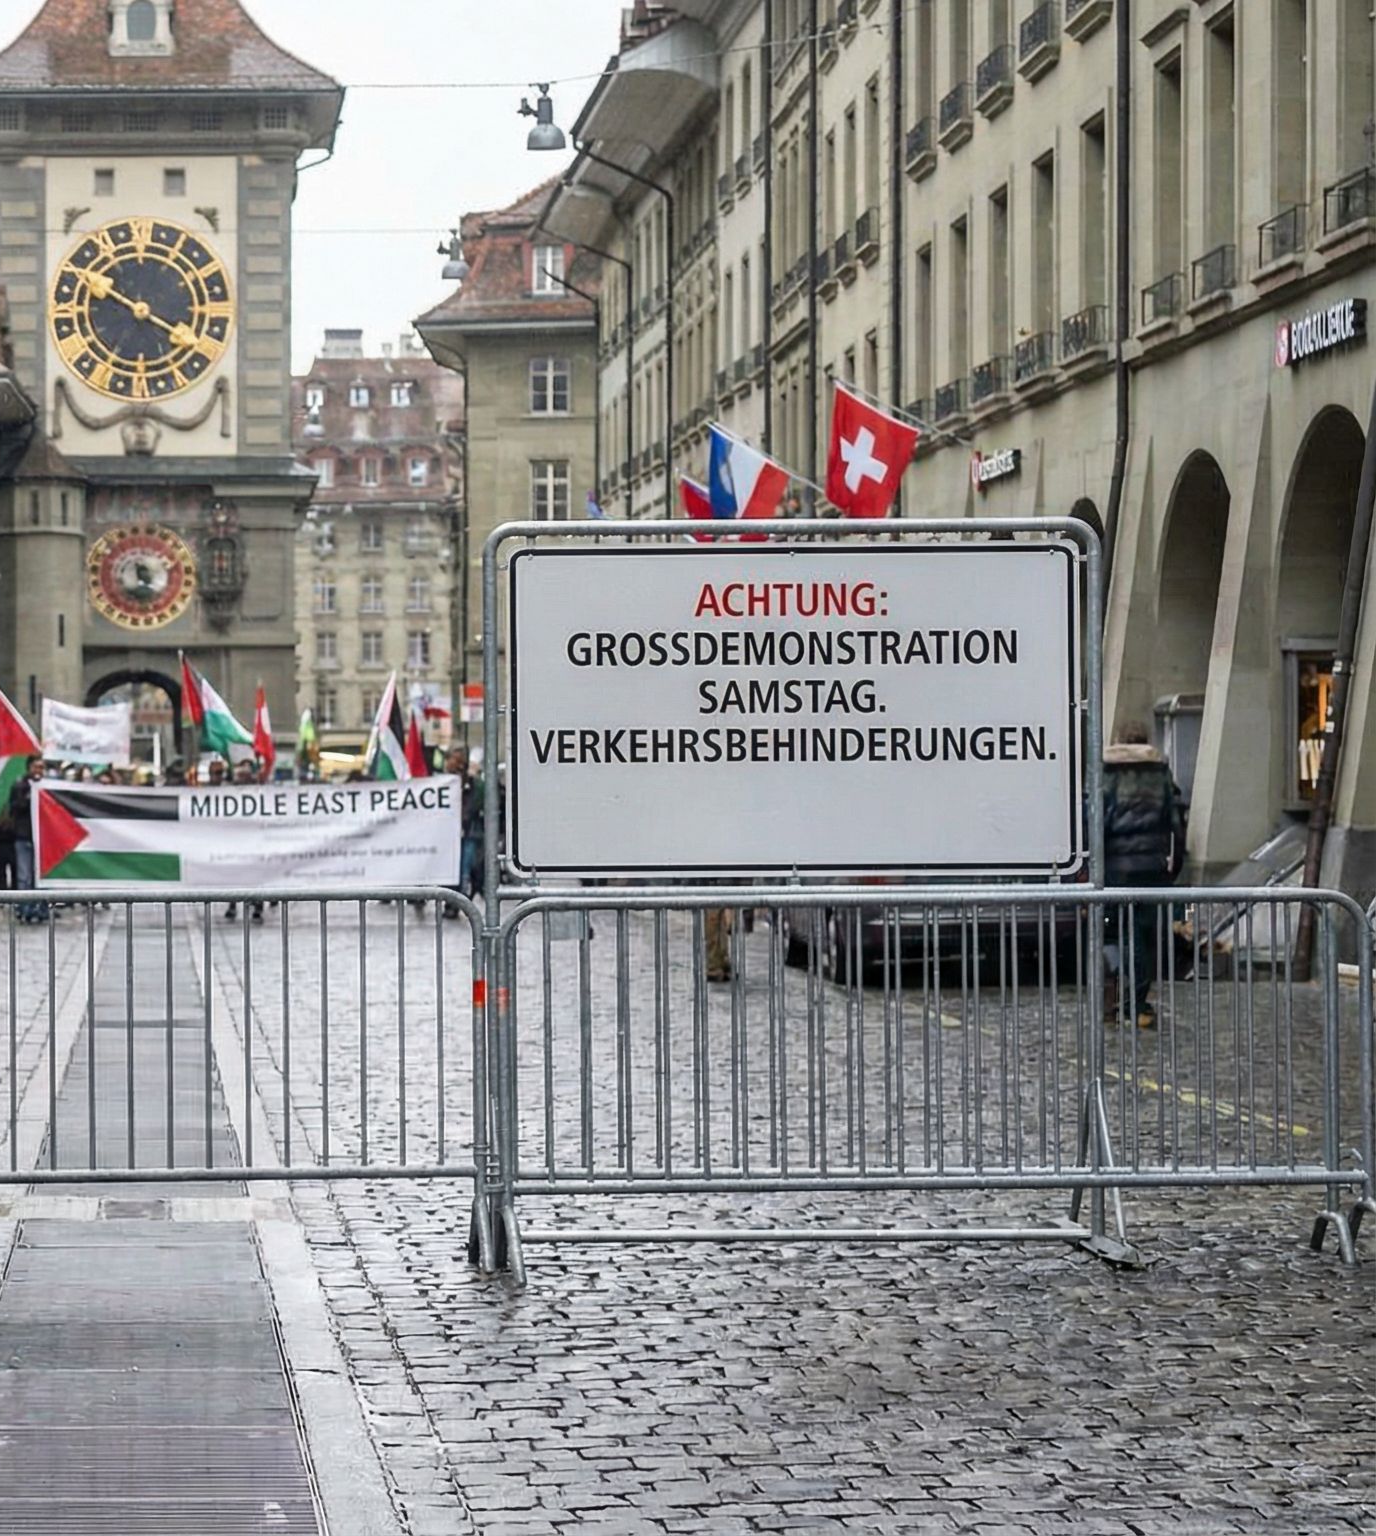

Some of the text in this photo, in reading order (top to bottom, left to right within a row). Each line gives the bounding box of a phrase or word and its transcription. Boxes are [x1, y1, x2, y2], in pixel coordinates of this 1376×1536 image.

[694, 582, 889, 617] ACHTUNG:
[566, 629, 1018, 667] GROSSDEMONSTRATION
[698, 679, 886, 714] SAMSTAG.
[529, 726, 1057, 764] VERKEHRSBEHINDERUNGEN.
[190, 786, 451, 817] MIDDLE EAST PEACE
